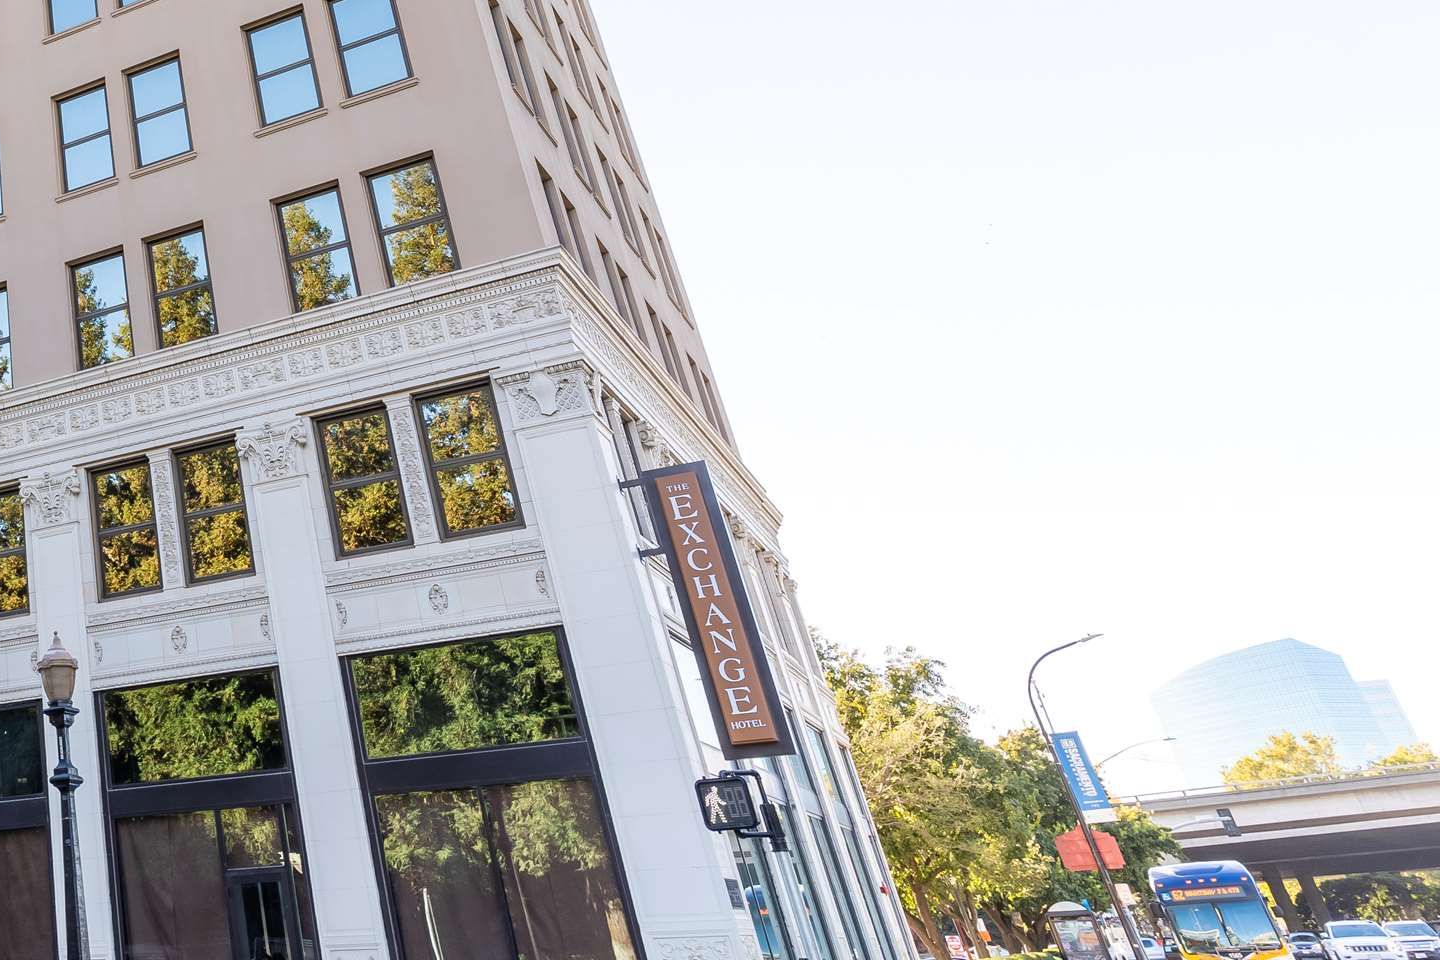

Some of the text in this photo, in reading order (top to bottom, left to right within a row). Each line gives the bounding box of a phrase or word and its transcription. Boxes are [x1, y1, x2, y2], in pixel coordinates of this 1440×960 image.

[666, 482, 689, 492] THE
[668, 493, 757, 715] EXCHANGE
[730, 718, 767, 730] HOTEL
